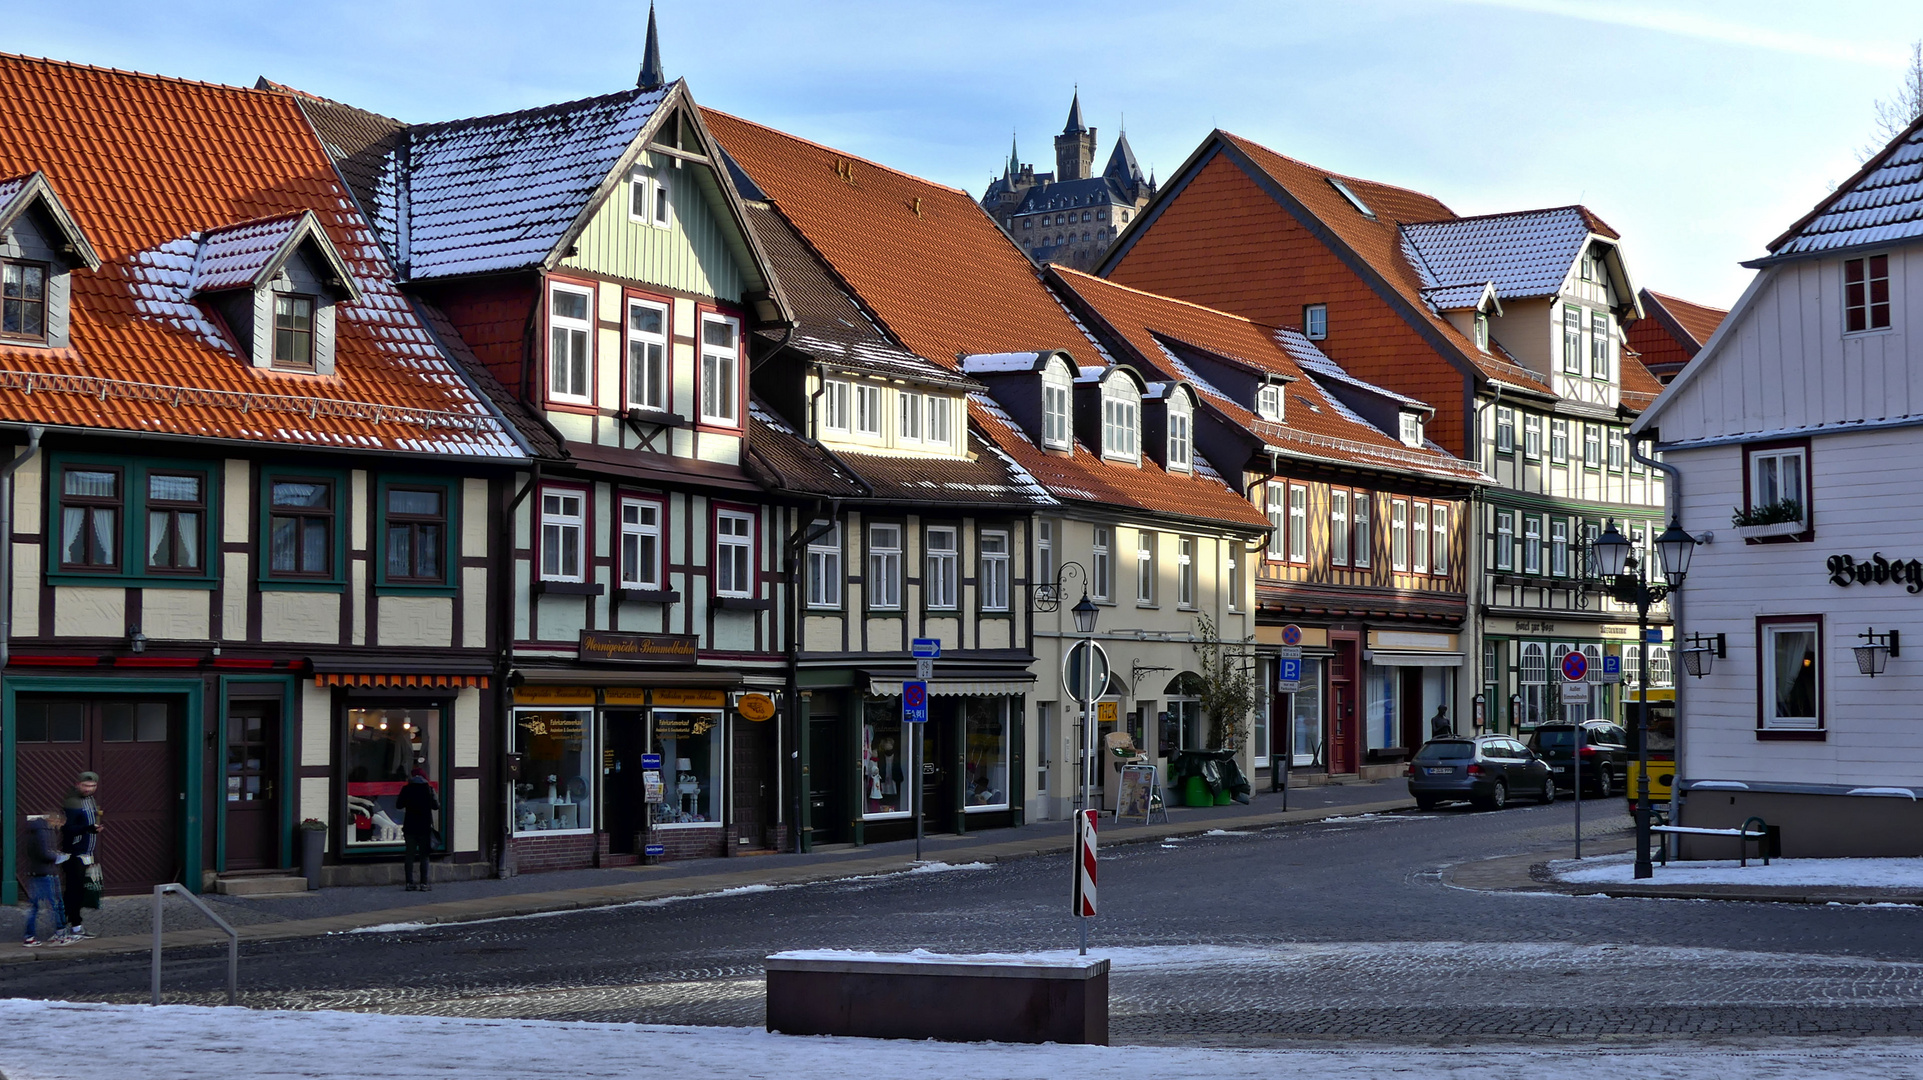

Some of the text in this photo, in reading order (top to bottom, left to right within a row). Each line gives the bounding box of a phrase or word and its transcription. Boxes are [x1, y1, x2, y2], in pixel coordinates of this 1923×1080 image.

[1515, 621, 1529, 631] Hotel
[1541, 621, 1554, 633] Post
[584, 636, 695, 658] Wernigeröder Bimmelbahn
[1284, 662, 1296, 678] P
[1606, 658, 1616, 671] P
[606, 690, 632, 698] Fahrkarten
